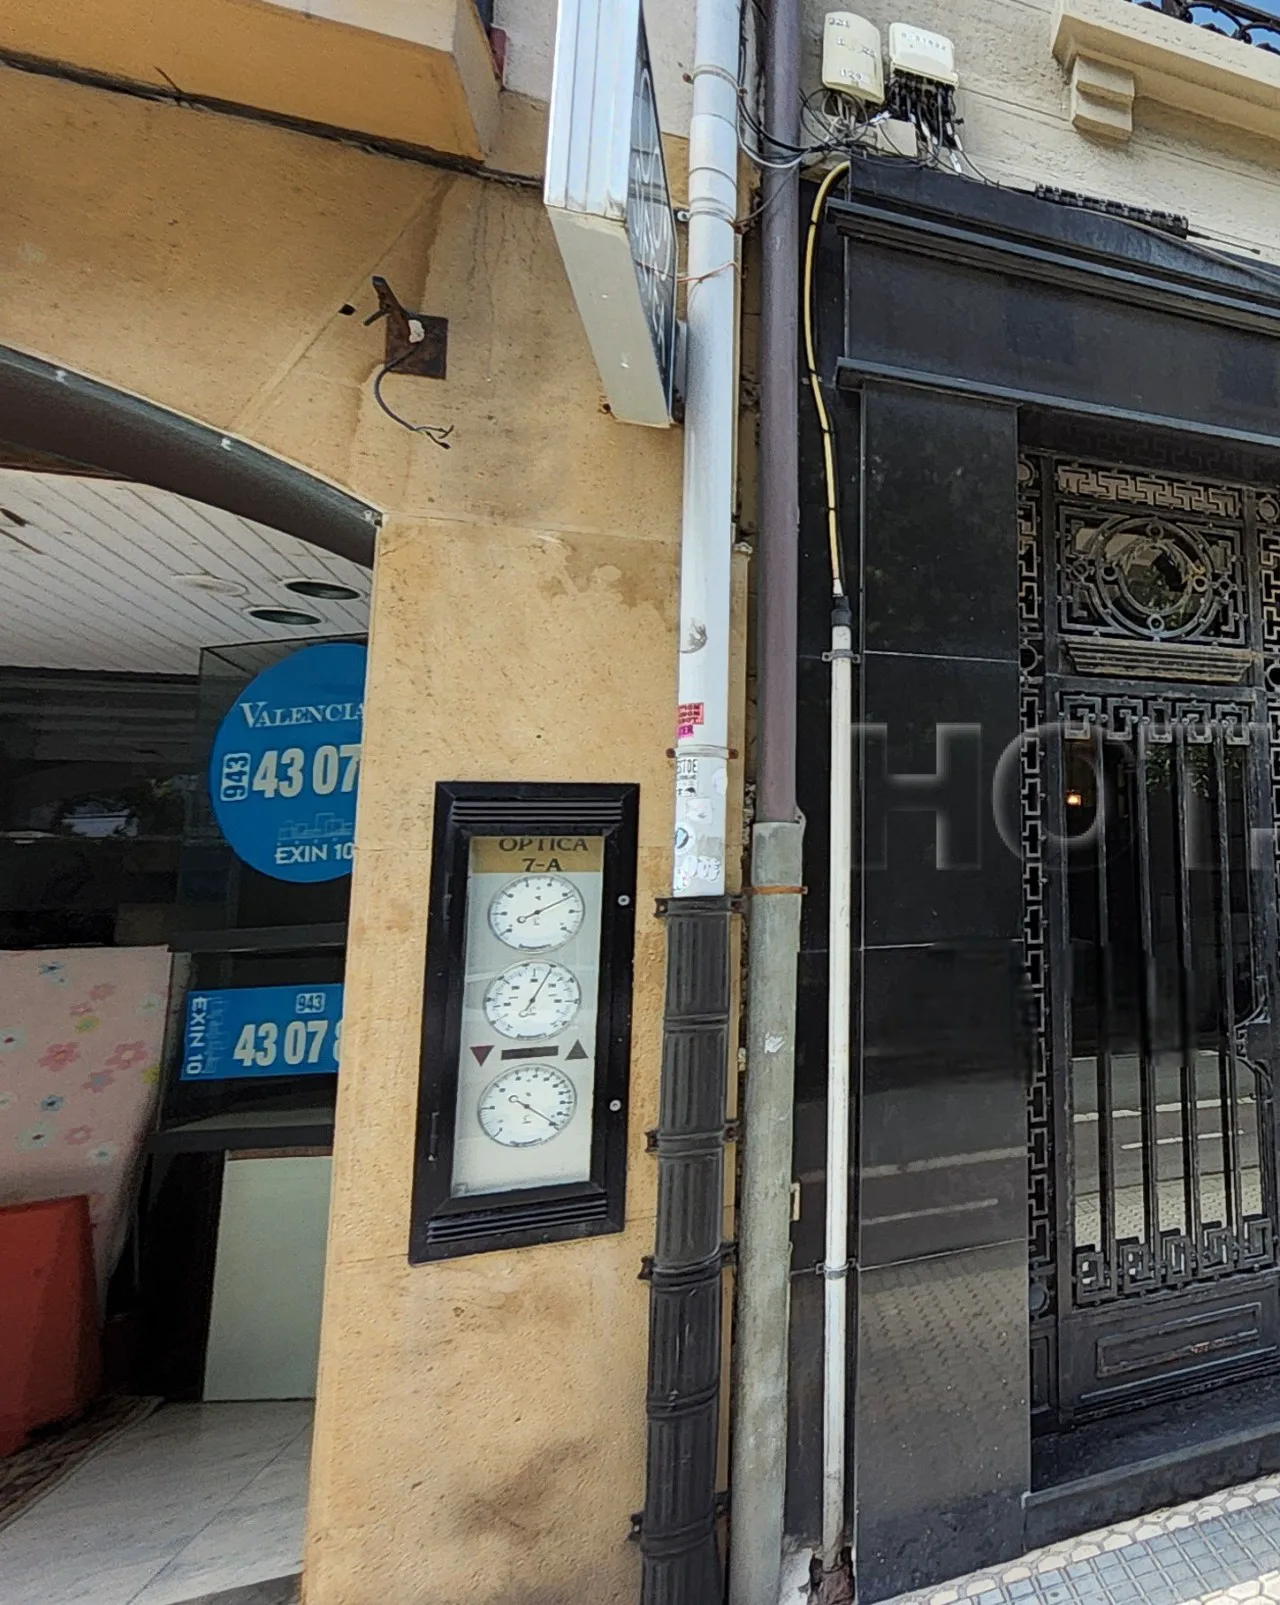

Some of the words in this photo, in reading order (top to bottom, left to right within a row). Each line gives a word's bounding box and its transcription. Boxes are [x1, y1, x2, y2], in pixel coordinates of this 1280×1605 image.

[223, 756, 249, 799] 943
[253, 748, 304, 798] 43
[313, 745, 363, 795] 07
[274, 844, 329, 864] EXIN
[499, 838, 589, 852] OPTICA
[521, 858, 563, 873] 7-A
[299, 994, 323, 1012] 943
[189, 997, 207, 1048] EXIN
[233, 1022, 278, 1067] 43
[284, 1020, 329, 1065] 07
[186, 1054, 204, 1074] 10
